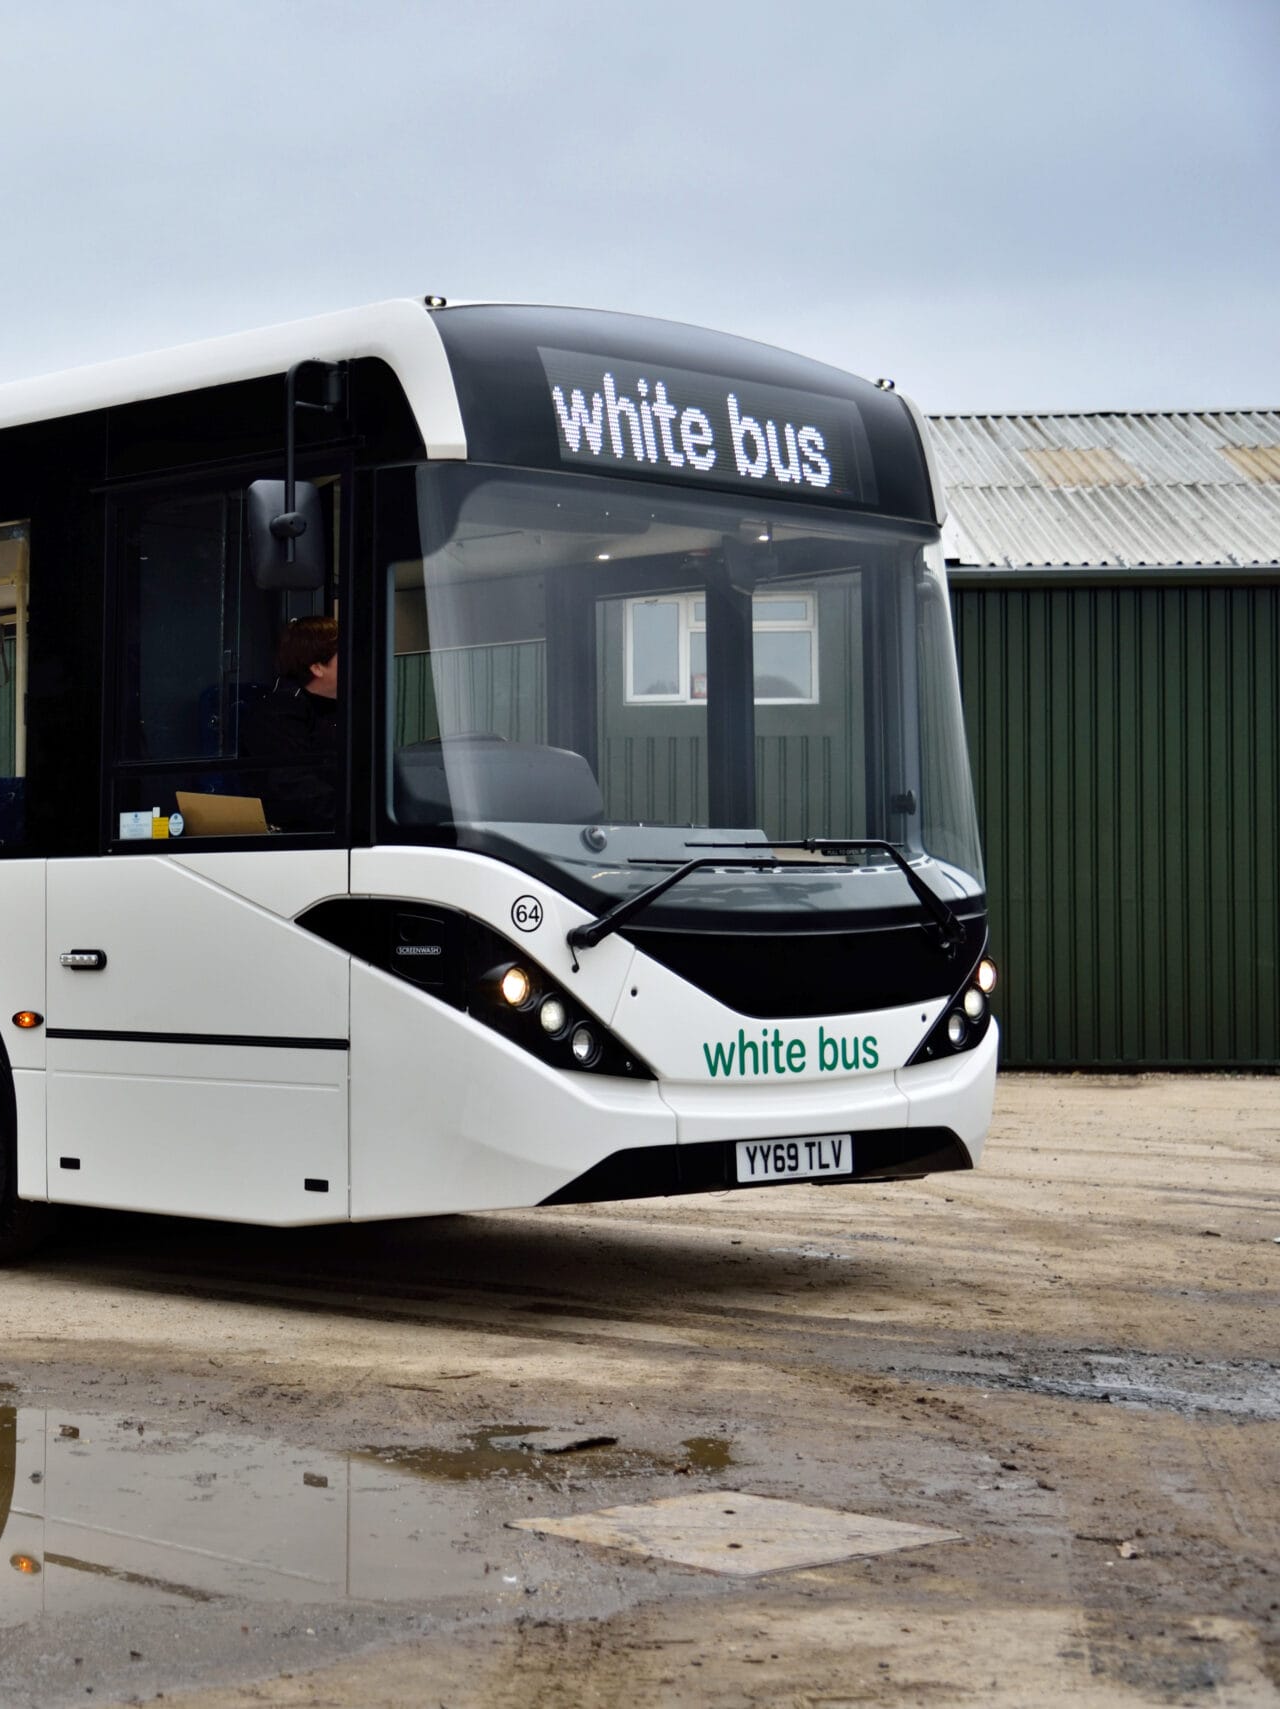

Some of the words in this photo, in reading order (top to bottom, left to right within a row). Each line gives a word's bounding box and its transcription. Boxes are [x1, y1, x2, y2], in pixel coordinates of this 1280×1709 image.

[552, 372, 716, 471] white
[727, 393, 831, 488] bus
[516, 904, 540, 923] 64
[399, 946, 439, 954] SCREENWASH
[703, 1028, 806, 1077] white
[818, 1025, 879, 1072] bus
[745, 1142, 799, 1175] YY69
[804, 1139, 842, 1170] TLV
